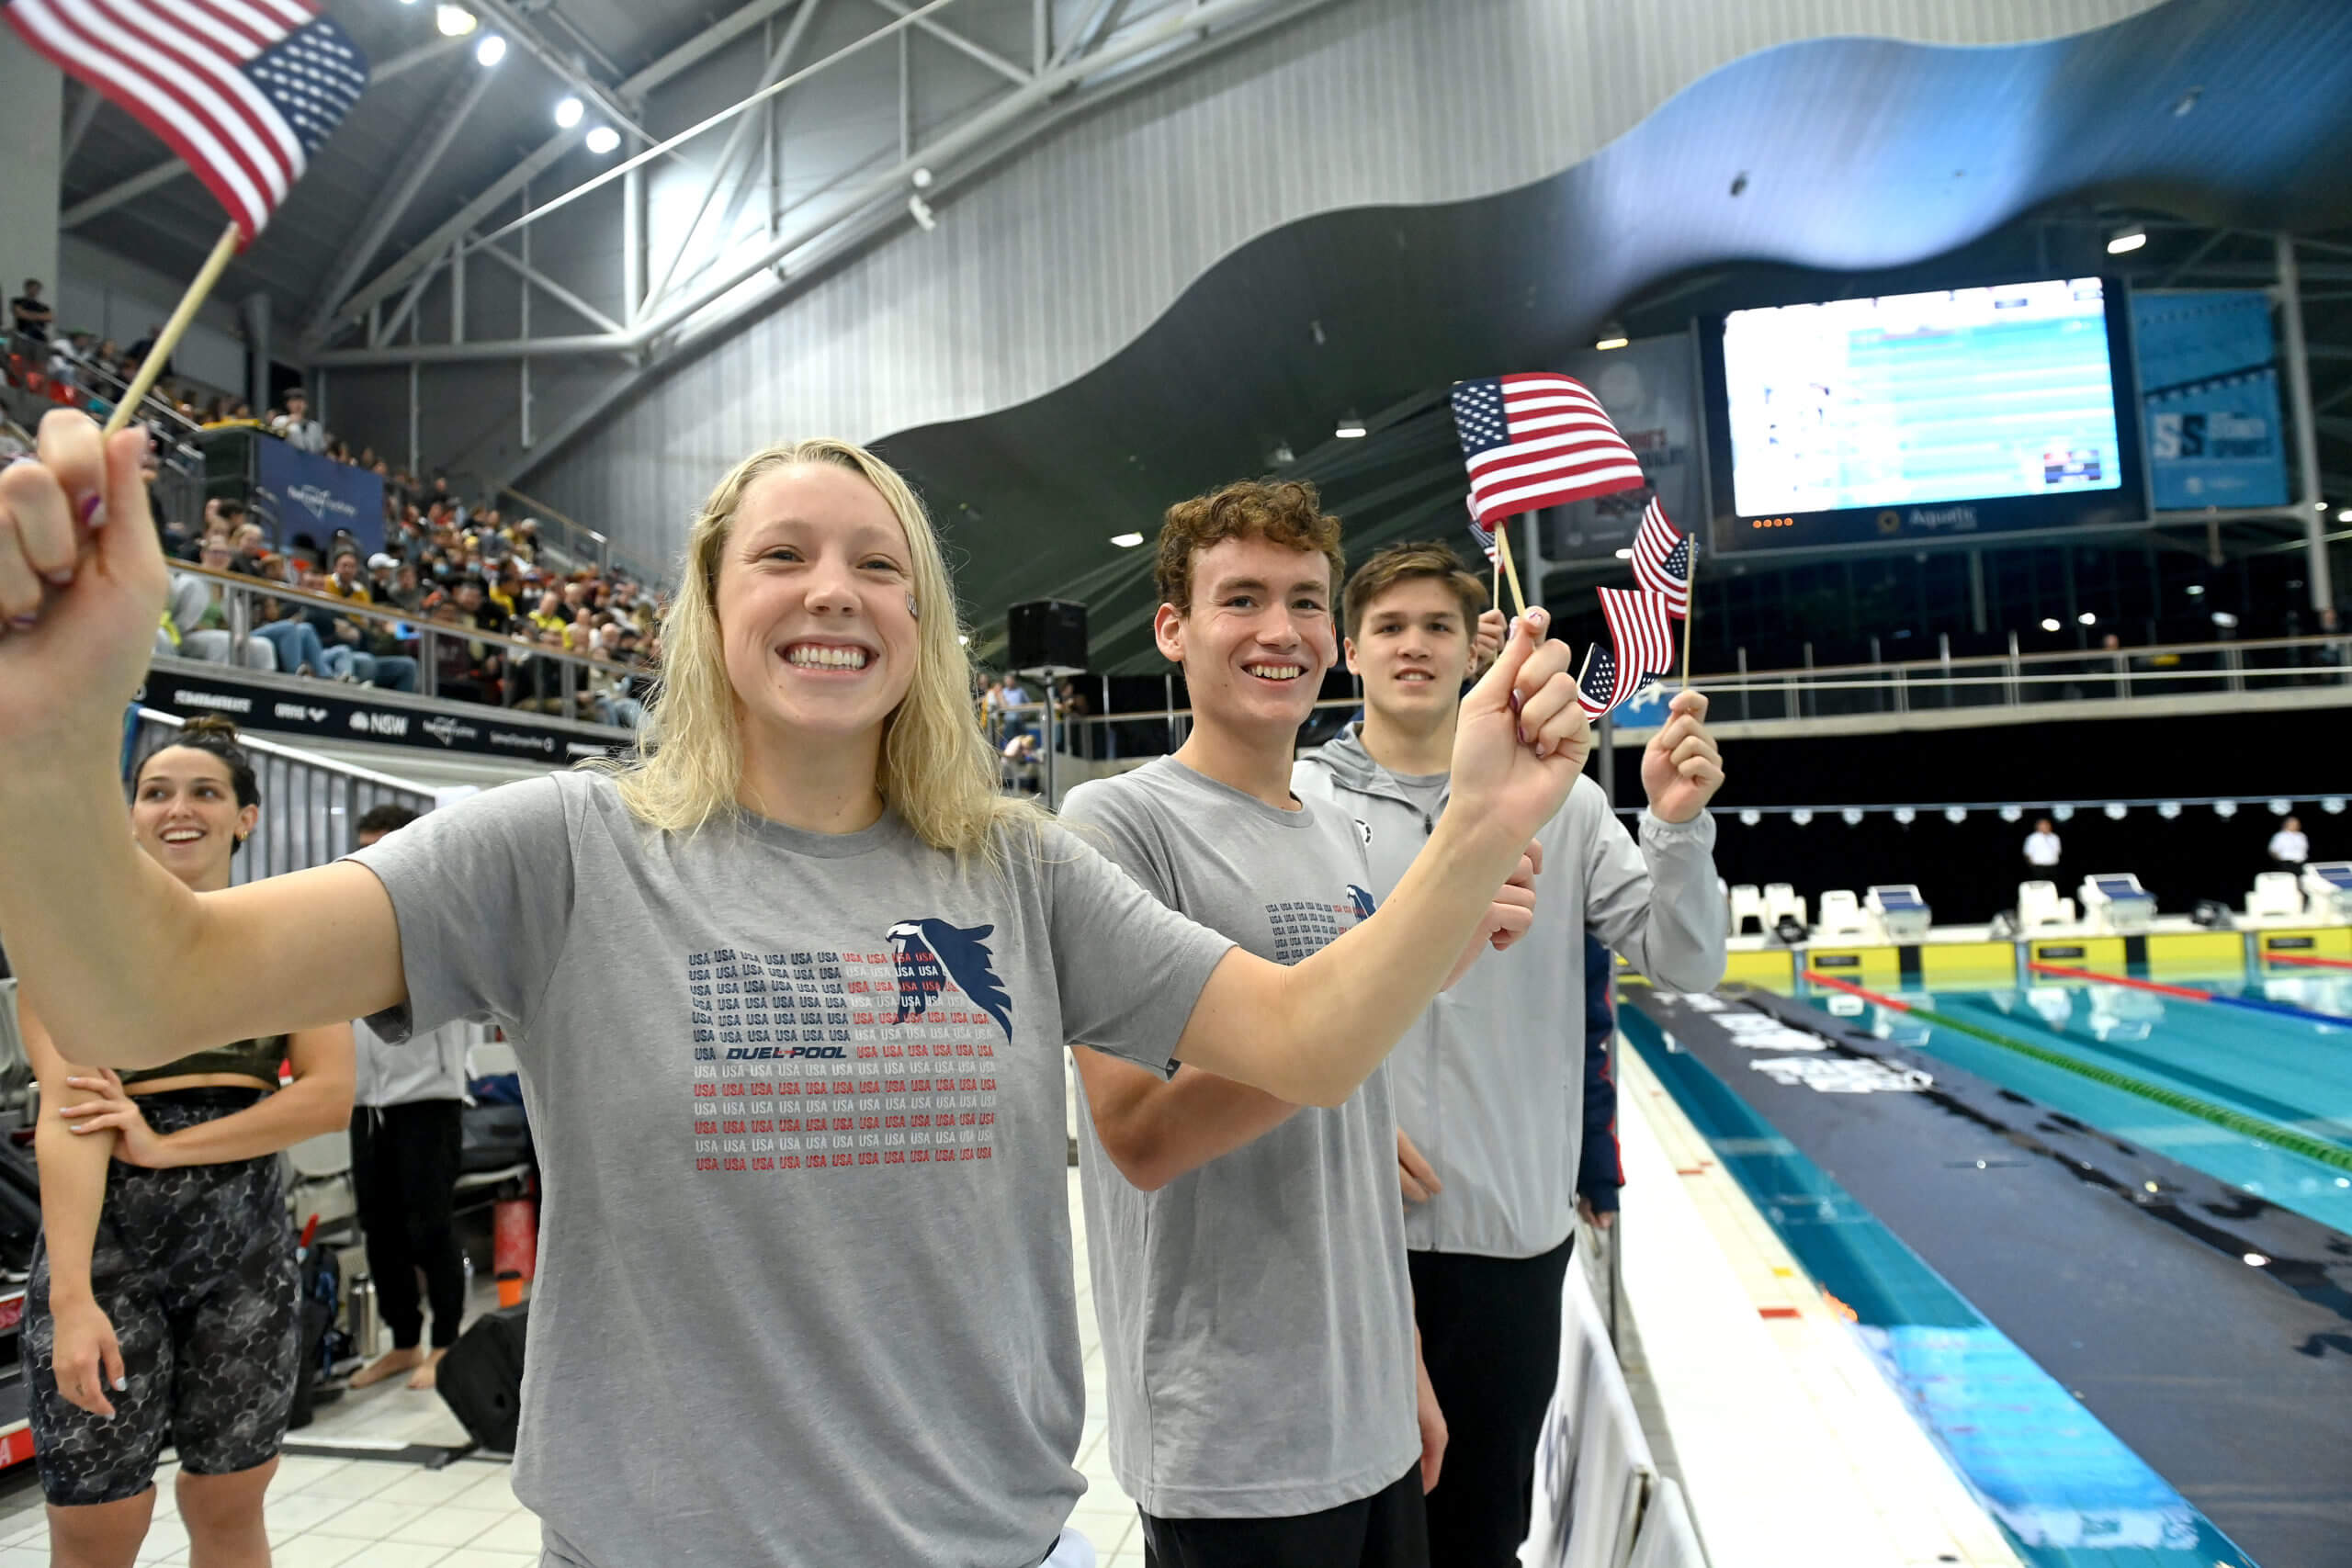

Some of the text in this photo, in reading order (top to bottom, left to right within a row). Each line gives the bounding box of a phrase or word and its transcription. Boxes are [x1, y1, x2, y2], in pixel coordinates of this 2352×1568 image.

[370, 713, 408, 735] NSW
[689, 950, 934, 965] USA USA USA USA USA USA USA USA USA USA
[689, 969, 710, 980] USA
[716, 965, 738, 978] USA
[742, 964, 764, 976] USA
[768, 967, 789, 978] USA
[794, 969, 815, 980] USA
[820, 967, 841, 979] USA
[897, 966, 914, 976] USA
[920, 966, 938, 976] USA
[690, 980, 941, 996] USA USA USA USA USA USA USA USA USA USA
[693, 996, 921, 1010] USA USA USA USA USA USA USA USA USA
[692, 1011, 989, 1026] USA USA USA USA USA USA USA USA USA USA USA USA
[694, 1027, 992, 1043] USA USA USA USA USA USA USA USA USA USA USA USA
[695, 1047, 716, 1060] USA
[857, 1046, 877, 1058] USA
[883, 1045, 903, 1057] USA
[908, 1044, 928, 1056] USA
[933, 1044, 952, 1055] USA
[956, 1044, 974, 1055] USA
[978, 1044, 993, 1056] USA
[695, 1061, 995, 1077] USA USA USA USA USA USA USA USA USA USA USA USA
[695, 1079, 996, 1096] USA USA USA USA USA USA USA USA USA USA USA USA
[695, 1103, 717, 1115] USA
[723, 1102, 745, 1114] USA
[752, 1101, 774, 1113] USA
[779, 1101, 800, 1112] USA
[807, 1100, 827, 1112] USA
[833, 1100, 853, 1111] USA
[860, 1099, 880, 1111] USA
[886, 1098, 905, 1110] USA
[911, 1098, 931, 1109] USA
[937, 1097, 955, 1108] USA
[960, 1097, 977, 1107] USA
[695, 1113, 994, 1134] USA USA USA USA USA USA USA USA USA USA USA USA
[695, 1141, 718, 1152] USA
[724, 1140, 746, 1152] USA
[752, 1139, 774, 1151] USA
[780, 1138, 800, 1150] USA
[807, 1137, 827, 1149] USA
[833, 1135, 854, 1148] USA
[860, 1134, 879, 1146] USA
[885, 1134, 905, 1145] USA
[911, 1133, 930, 1145] USA
[936, 1132, 956, 1144] USA
[959, 1131, 975, 1143] USA
[696, 1147, 991, 1170] USA USA USA USA USA USA USA USA USA USA USA USA
